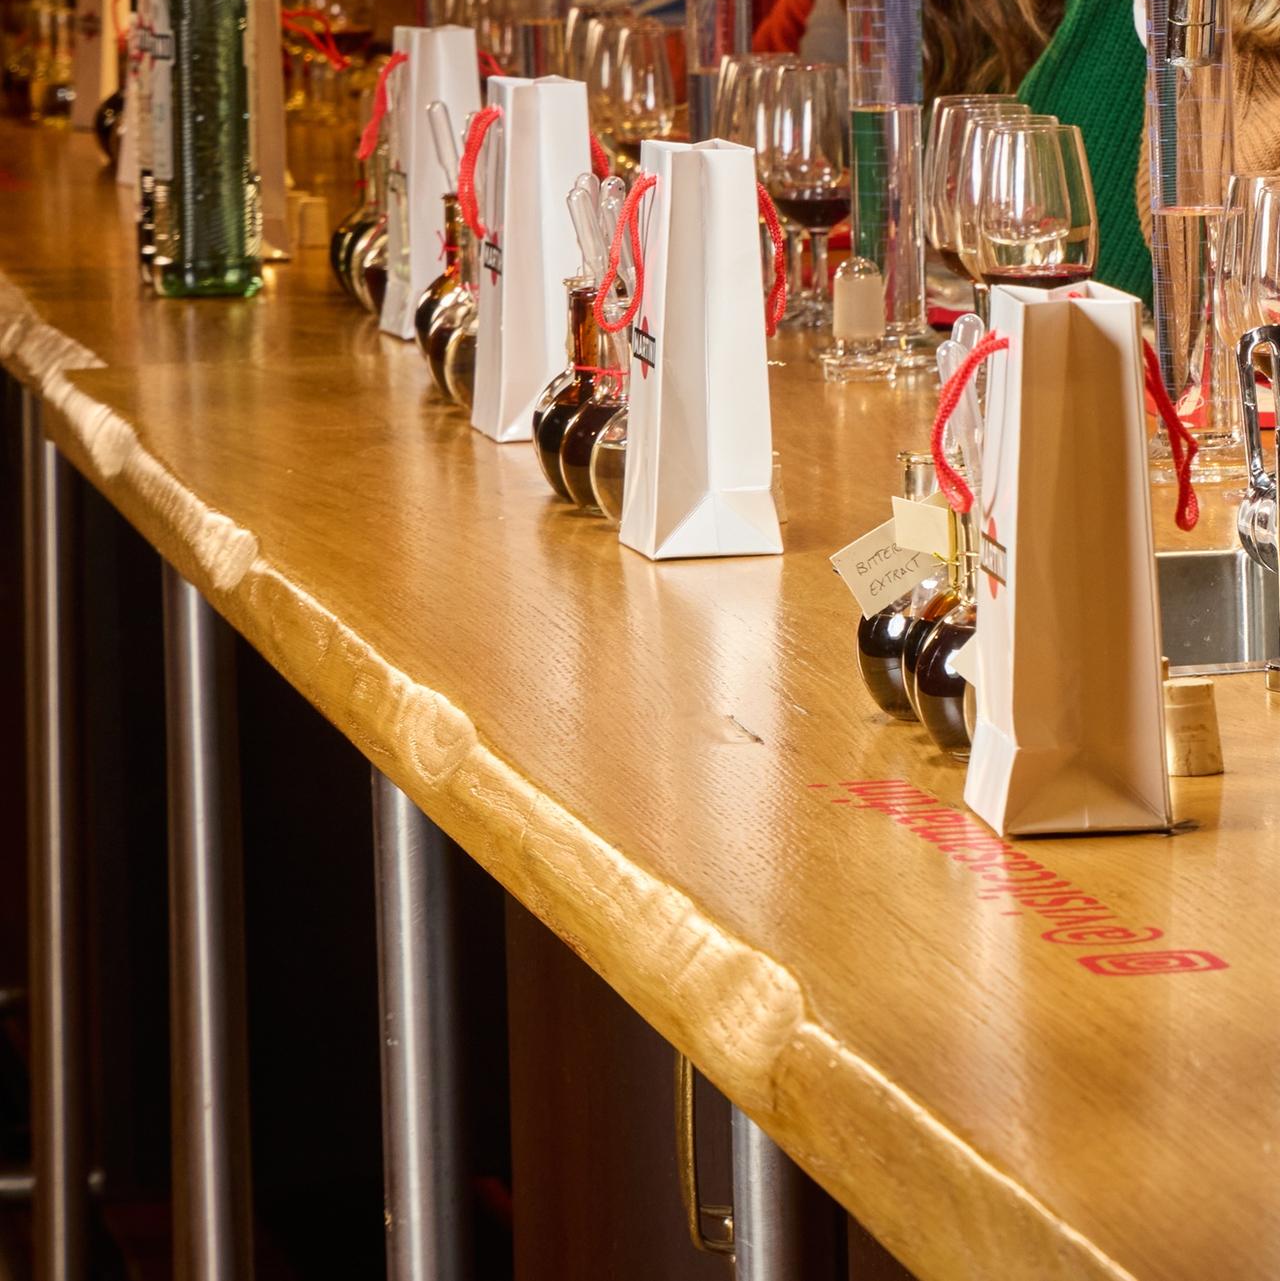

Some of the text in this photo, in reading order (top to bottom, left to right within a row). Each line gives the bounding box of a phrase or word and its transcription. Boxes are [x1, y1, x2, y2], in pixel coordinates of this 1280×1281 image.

[856, 543, 902, 576] BITTER
[869, 552, 921, 596] EXTRACT
[808, 778, 1165, 946] @visitcasamartini
